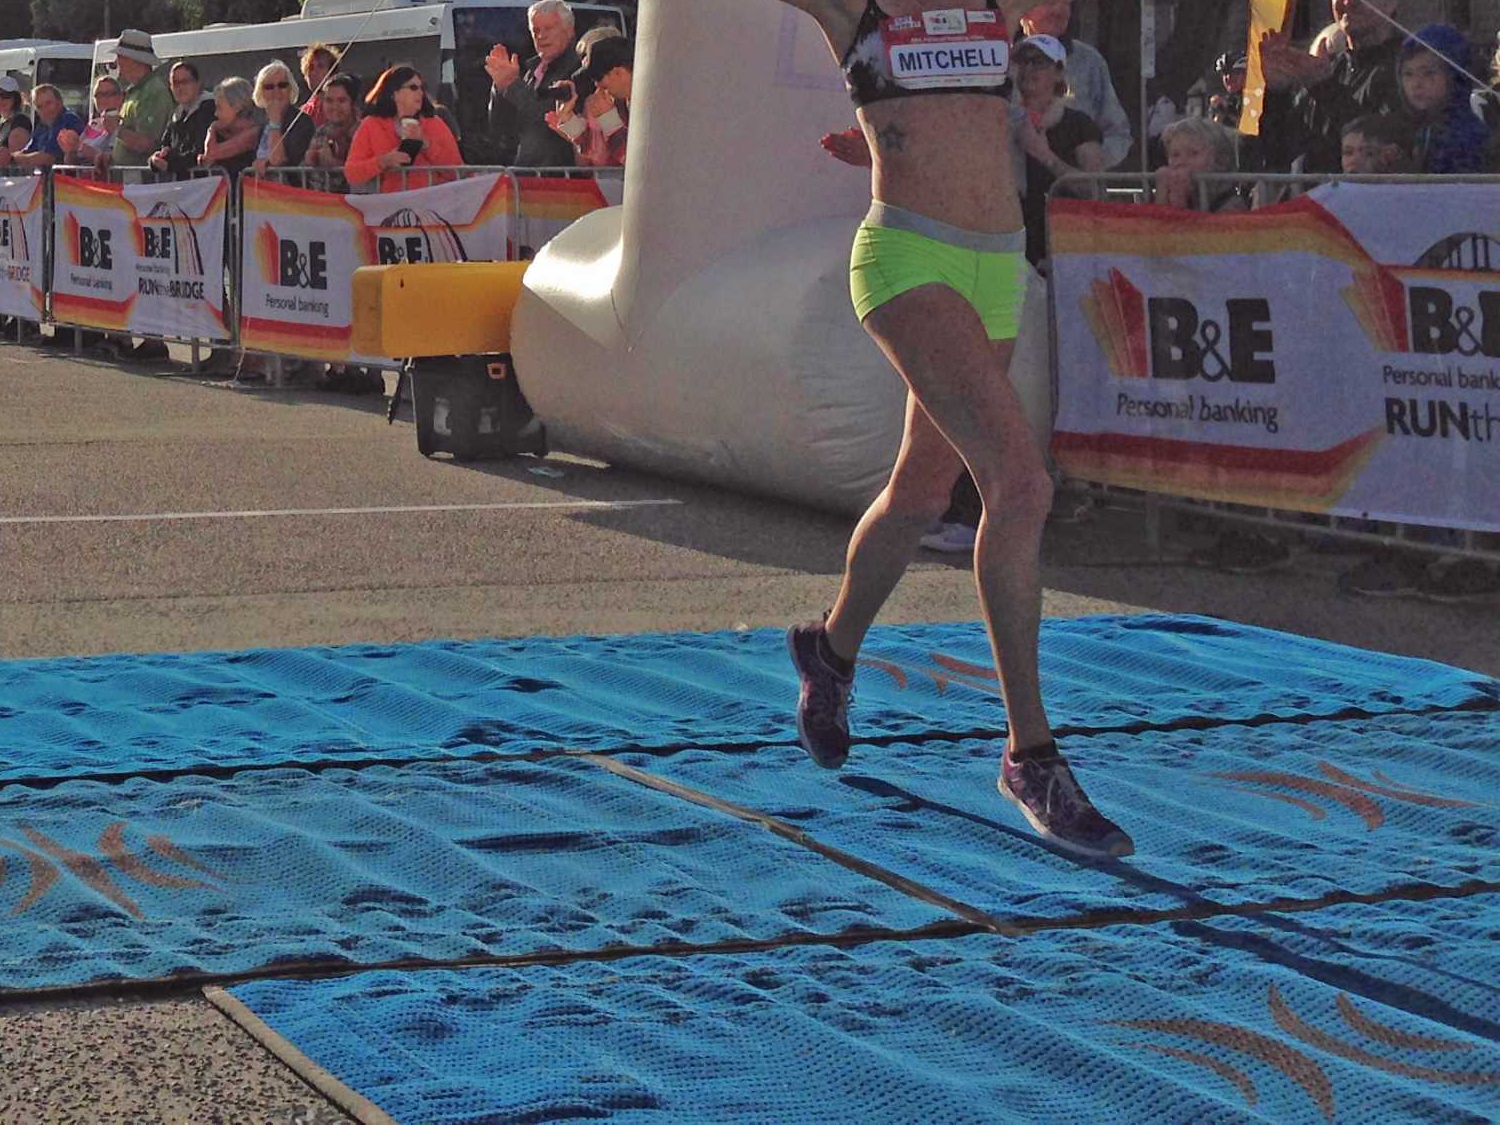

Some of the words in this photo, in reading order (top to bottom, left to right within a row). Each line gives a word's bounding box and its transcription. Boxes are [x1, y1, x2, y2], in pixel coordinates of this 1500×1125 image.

[898, 47, 1003, 72] MITCHELL
[80, 226, 113, 270] B&E
[280, 239, 327, 290] B&E
[265, 293, 297, 311] Personal
[1147, 296, 1276, 384] B&E
[1383, 364, 1453, 388] Personal
[1116, 393, 1194, 419] Personal
[1199, 396, 1279, 434] banking
